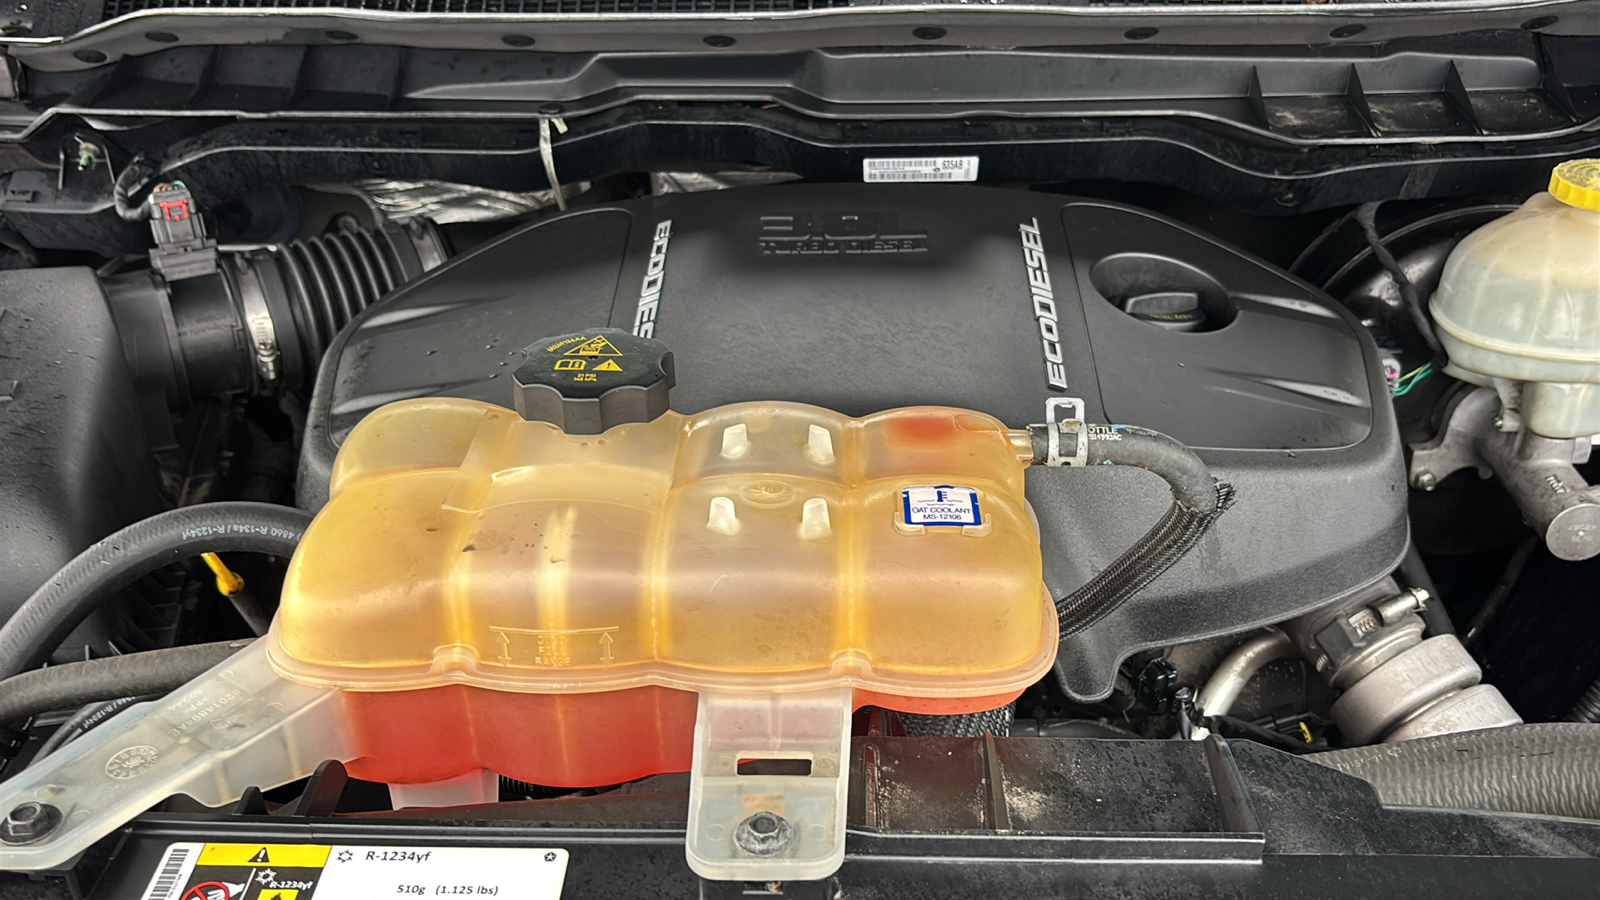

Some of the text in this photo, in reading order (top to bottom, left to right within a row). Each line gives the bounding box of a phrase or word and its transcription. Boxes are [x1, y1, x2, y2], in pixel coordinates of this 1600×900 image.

[1018, 217, 1068, 392] ECODIESEL
[911, 506, 972, 514] OAT COOLANT
[182, 524, 226, 540] R-1234yf
[232, 524, 268, 535] R-134a
[270, 527, 295, 540] 4860
[534, 656, 572, 667] RANGE
[365, 850, 432, 864] R-1234yf
[269, 880, 314, 891] R-1234yf
[396, 884, 499, 896] 510g (1.125 lbs)
